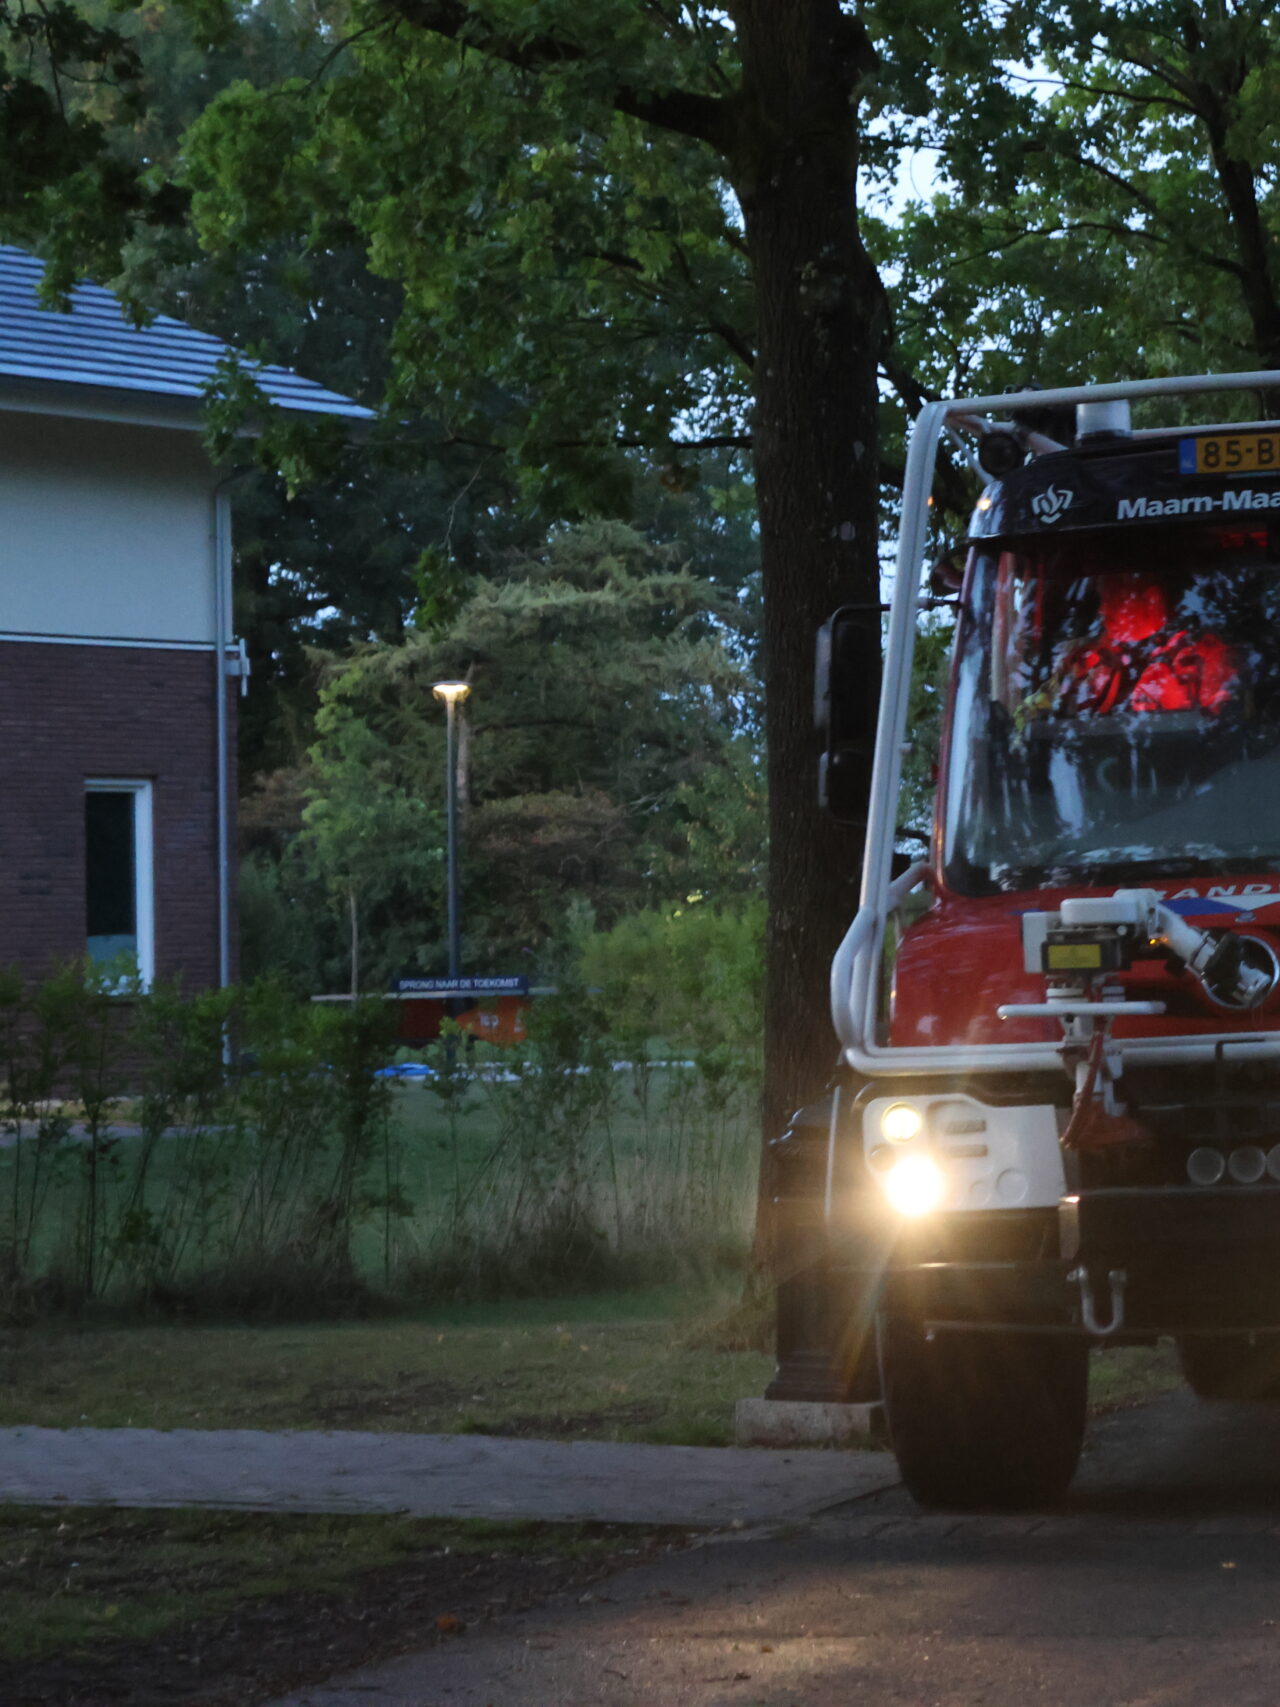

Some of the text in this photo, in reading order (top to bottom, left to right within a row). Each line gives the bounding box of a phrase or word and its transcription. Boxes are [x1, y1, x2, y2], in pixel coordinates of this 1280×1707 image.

[400, 977, 519, 990] SPRONG NAAR DE TOEKOMST
